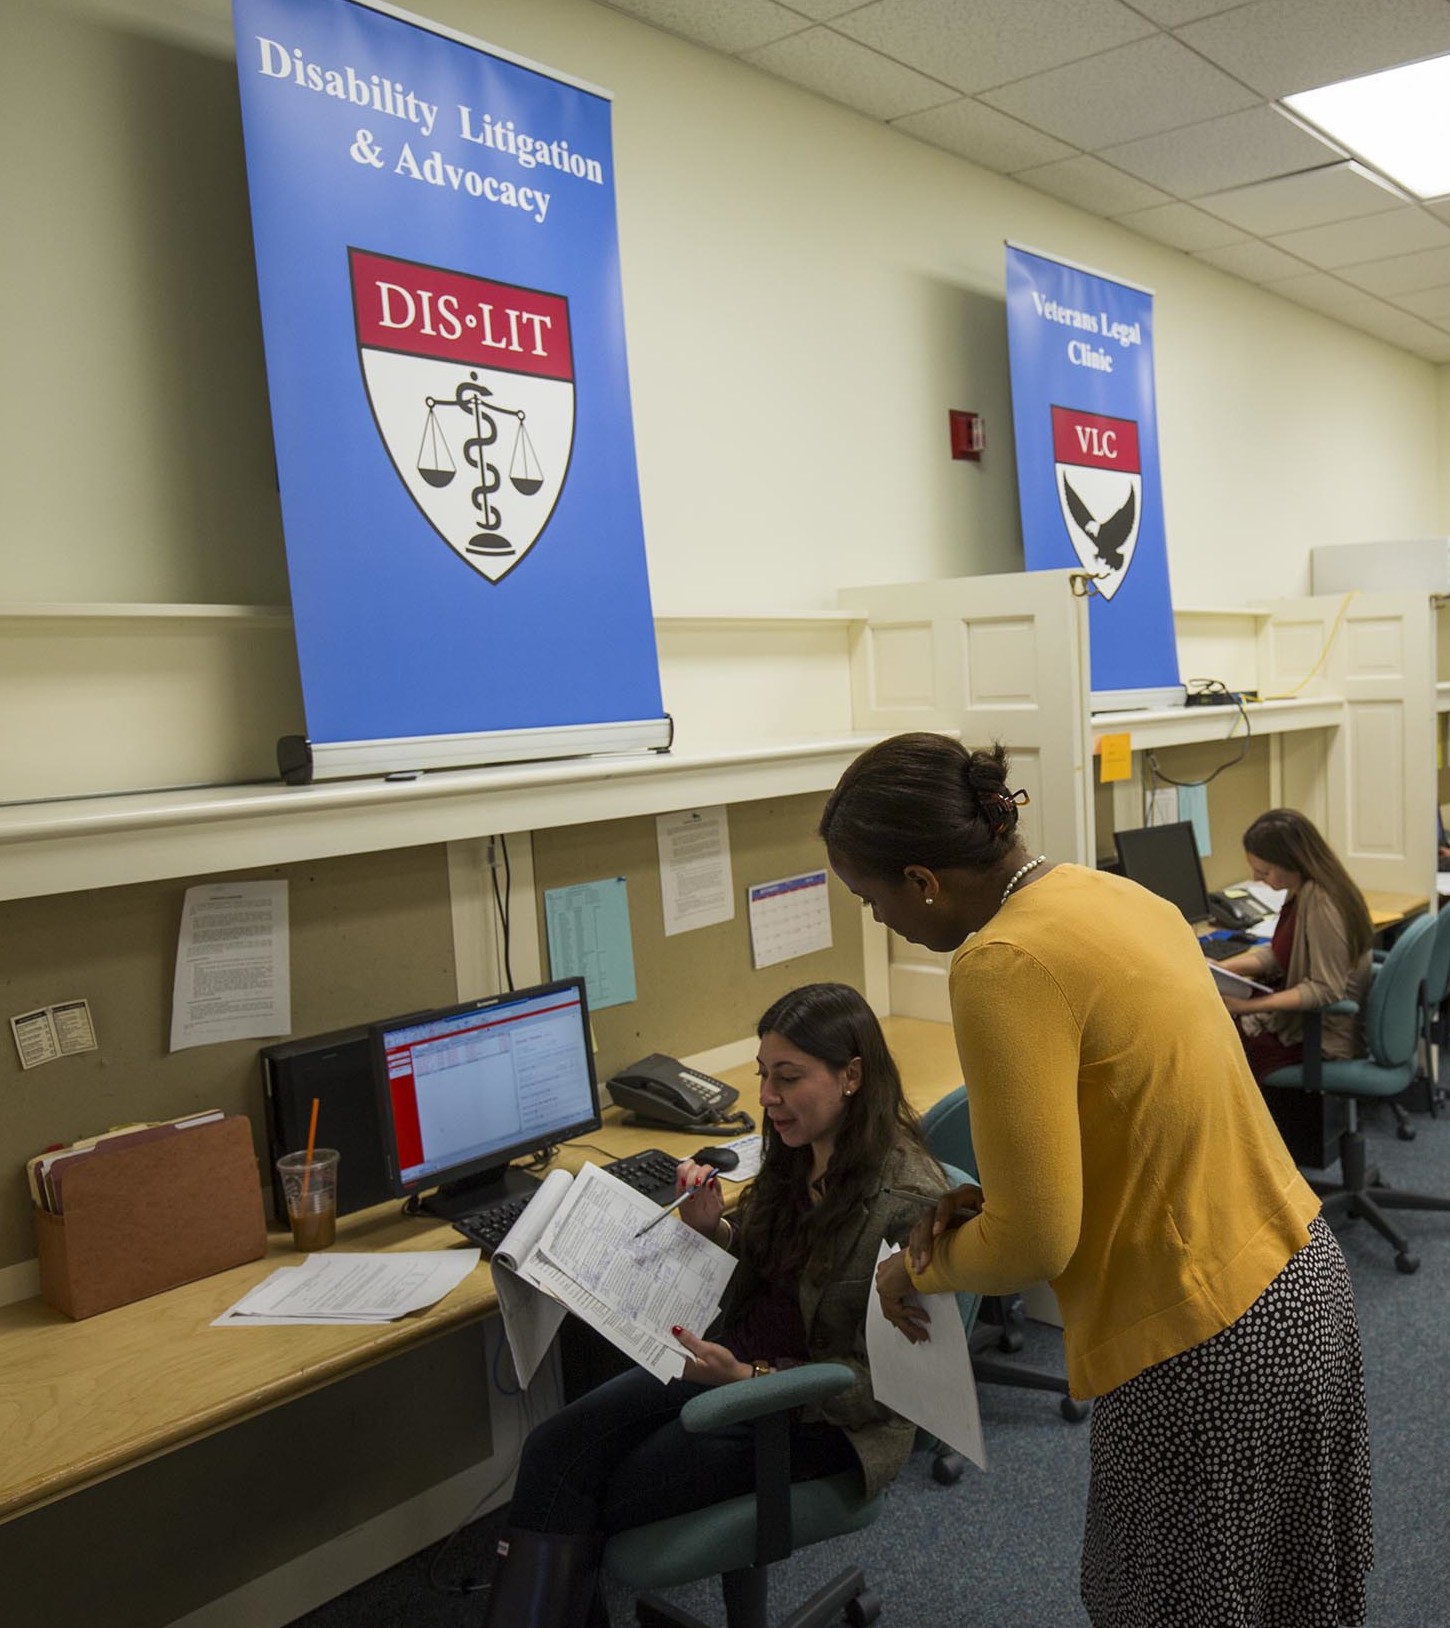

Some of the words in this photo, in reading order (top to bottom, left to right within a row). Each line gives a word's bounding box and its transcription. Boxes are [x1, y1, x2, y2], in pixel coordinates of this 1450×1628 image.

[256, 36, 438, 136] Disability
[457, 105, 604, 184] Litigation
[349, 128, 384, 168] &
[394, 142, 551, 223] Advocacy
[1032, 290, 1099, 334] Veterans
[1100, 312, 1142, 347] Legal
[1068, 341, 1112, 372] Clinic
[1075, 426, 1117, 458] VLC
